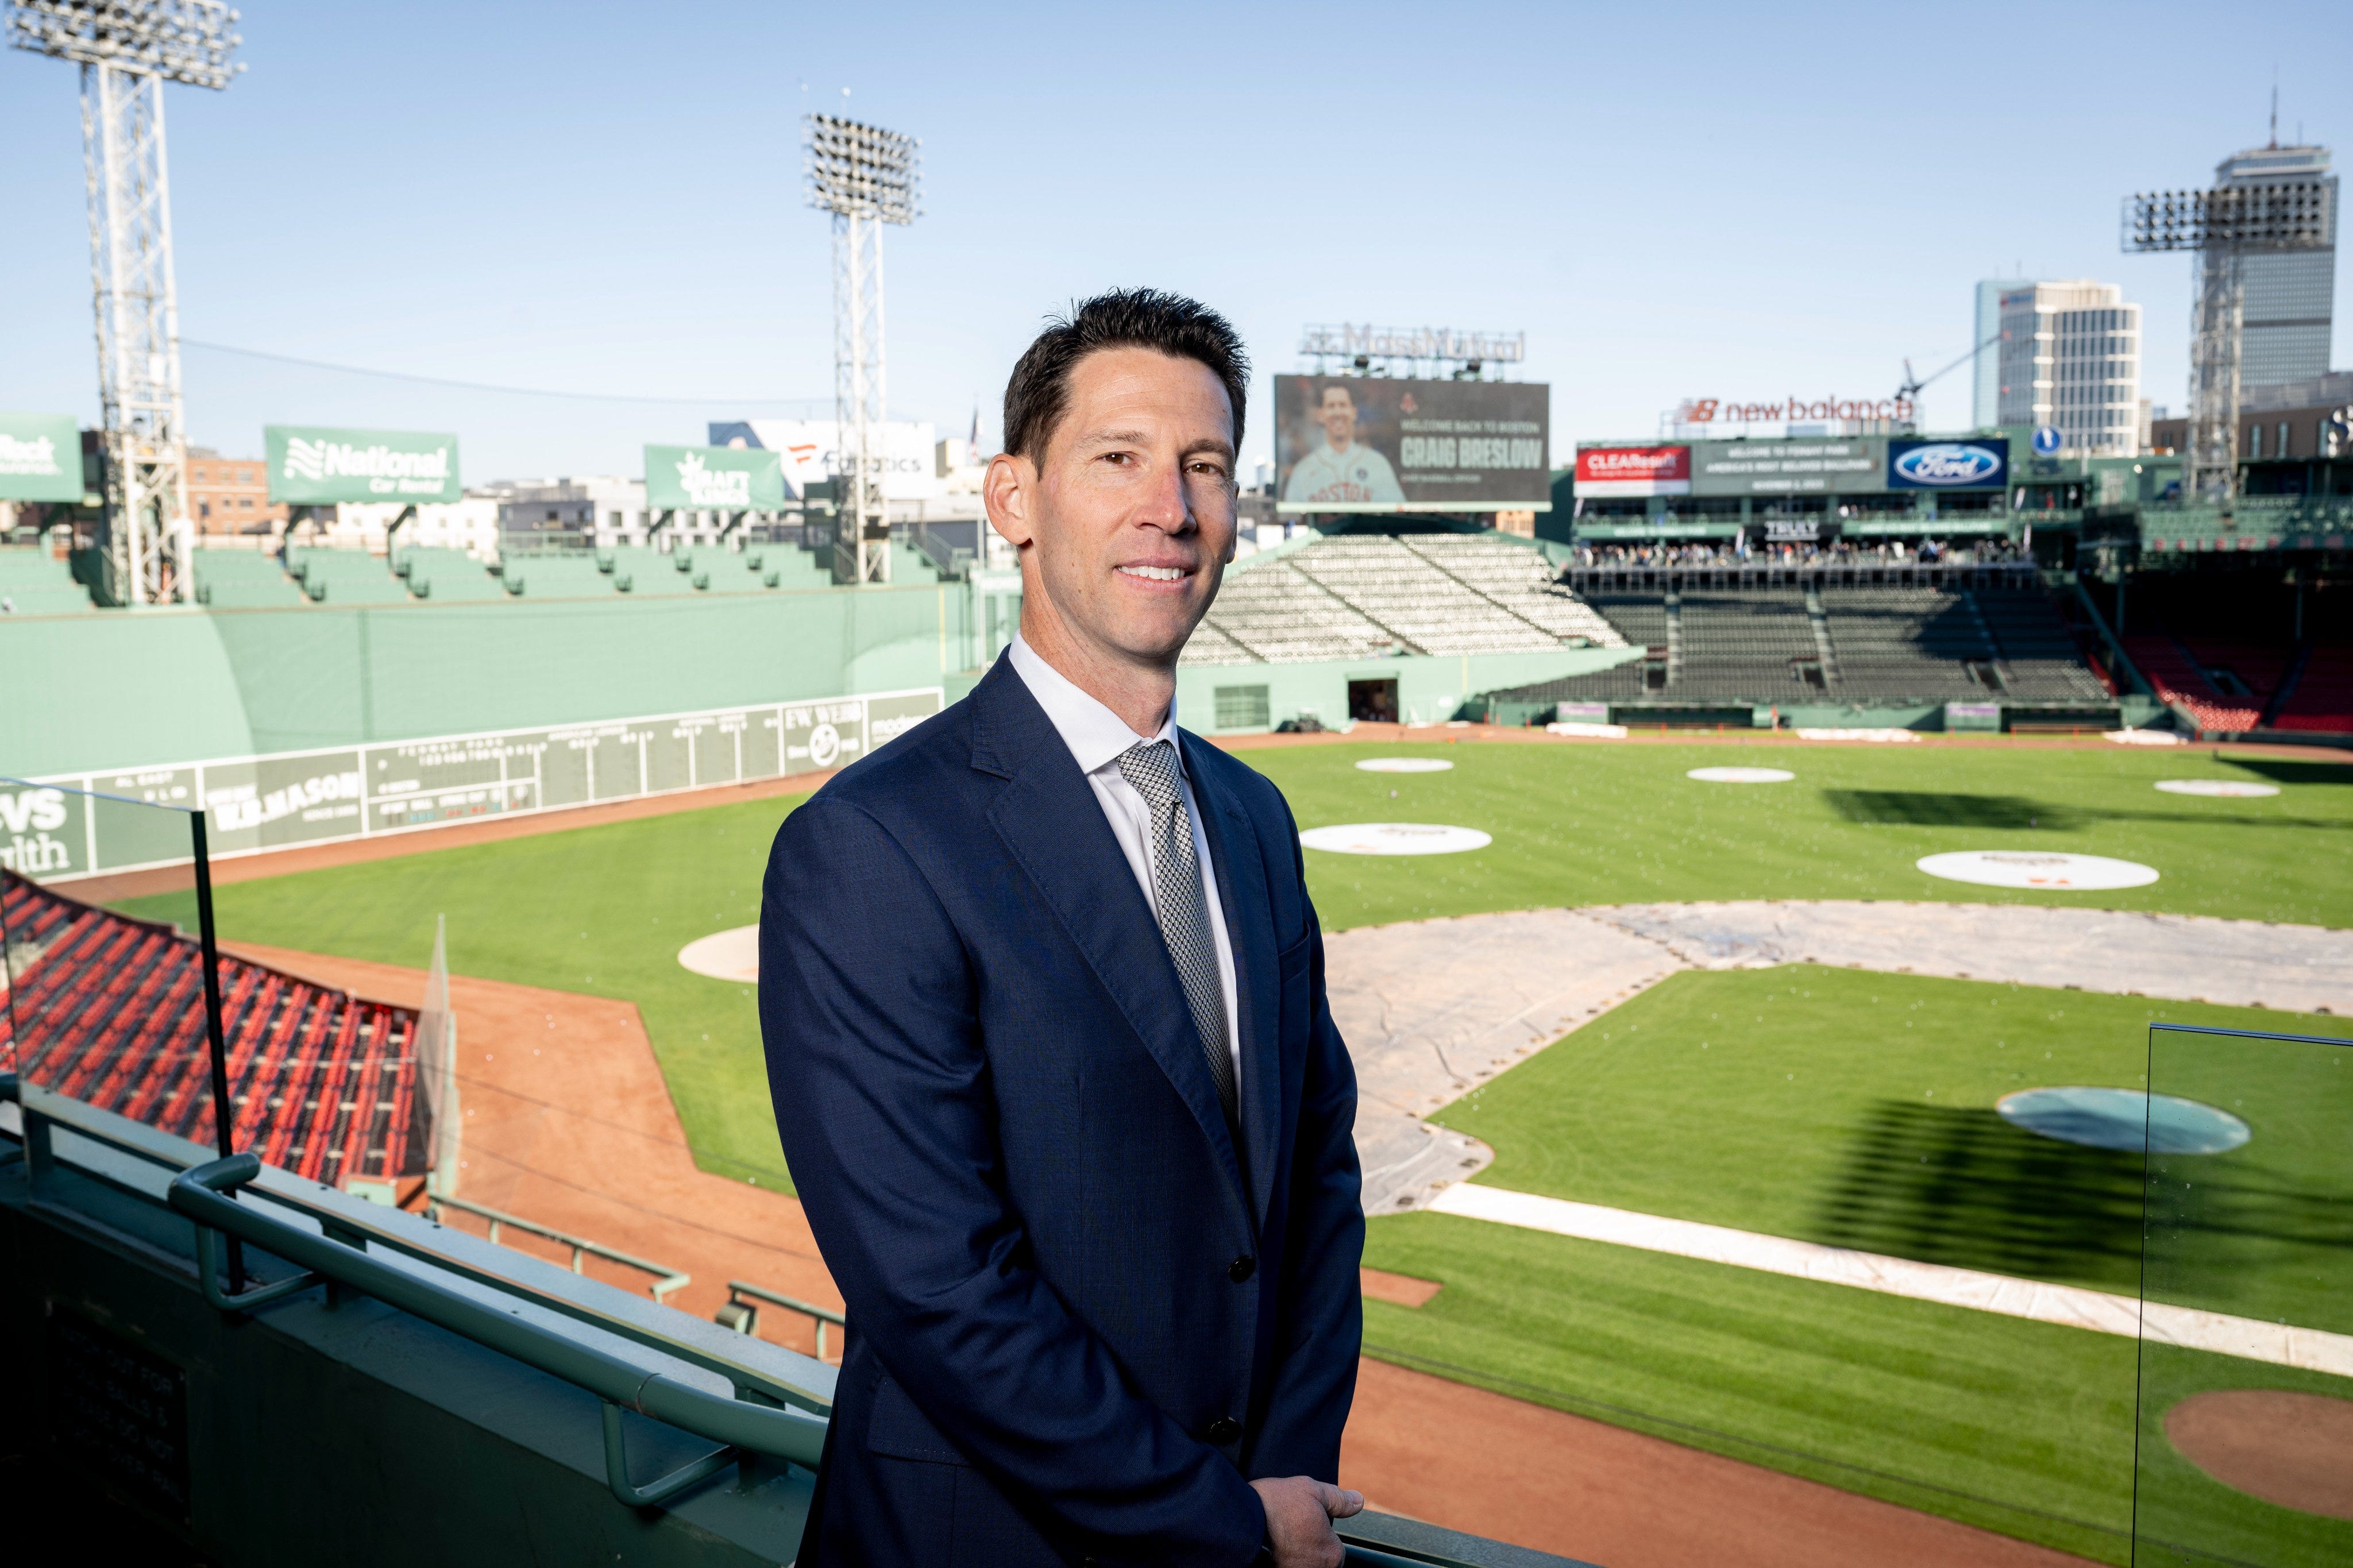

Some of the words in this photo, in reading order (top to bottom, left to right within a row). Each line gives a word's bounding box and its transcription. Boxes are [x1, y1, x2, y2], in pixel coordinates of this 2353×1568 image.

[1726, 403, 1783, 422] new
[1789, 394, 1914, 422] balance
[323, 442, 448, 478] National
[1400, 436, 1457, 468] CRAIG
[1458, 437, 1544, 469] BRESLOW
[1915, 450, 1980, 478] Ford
[0, 787, 67, 834] VS
